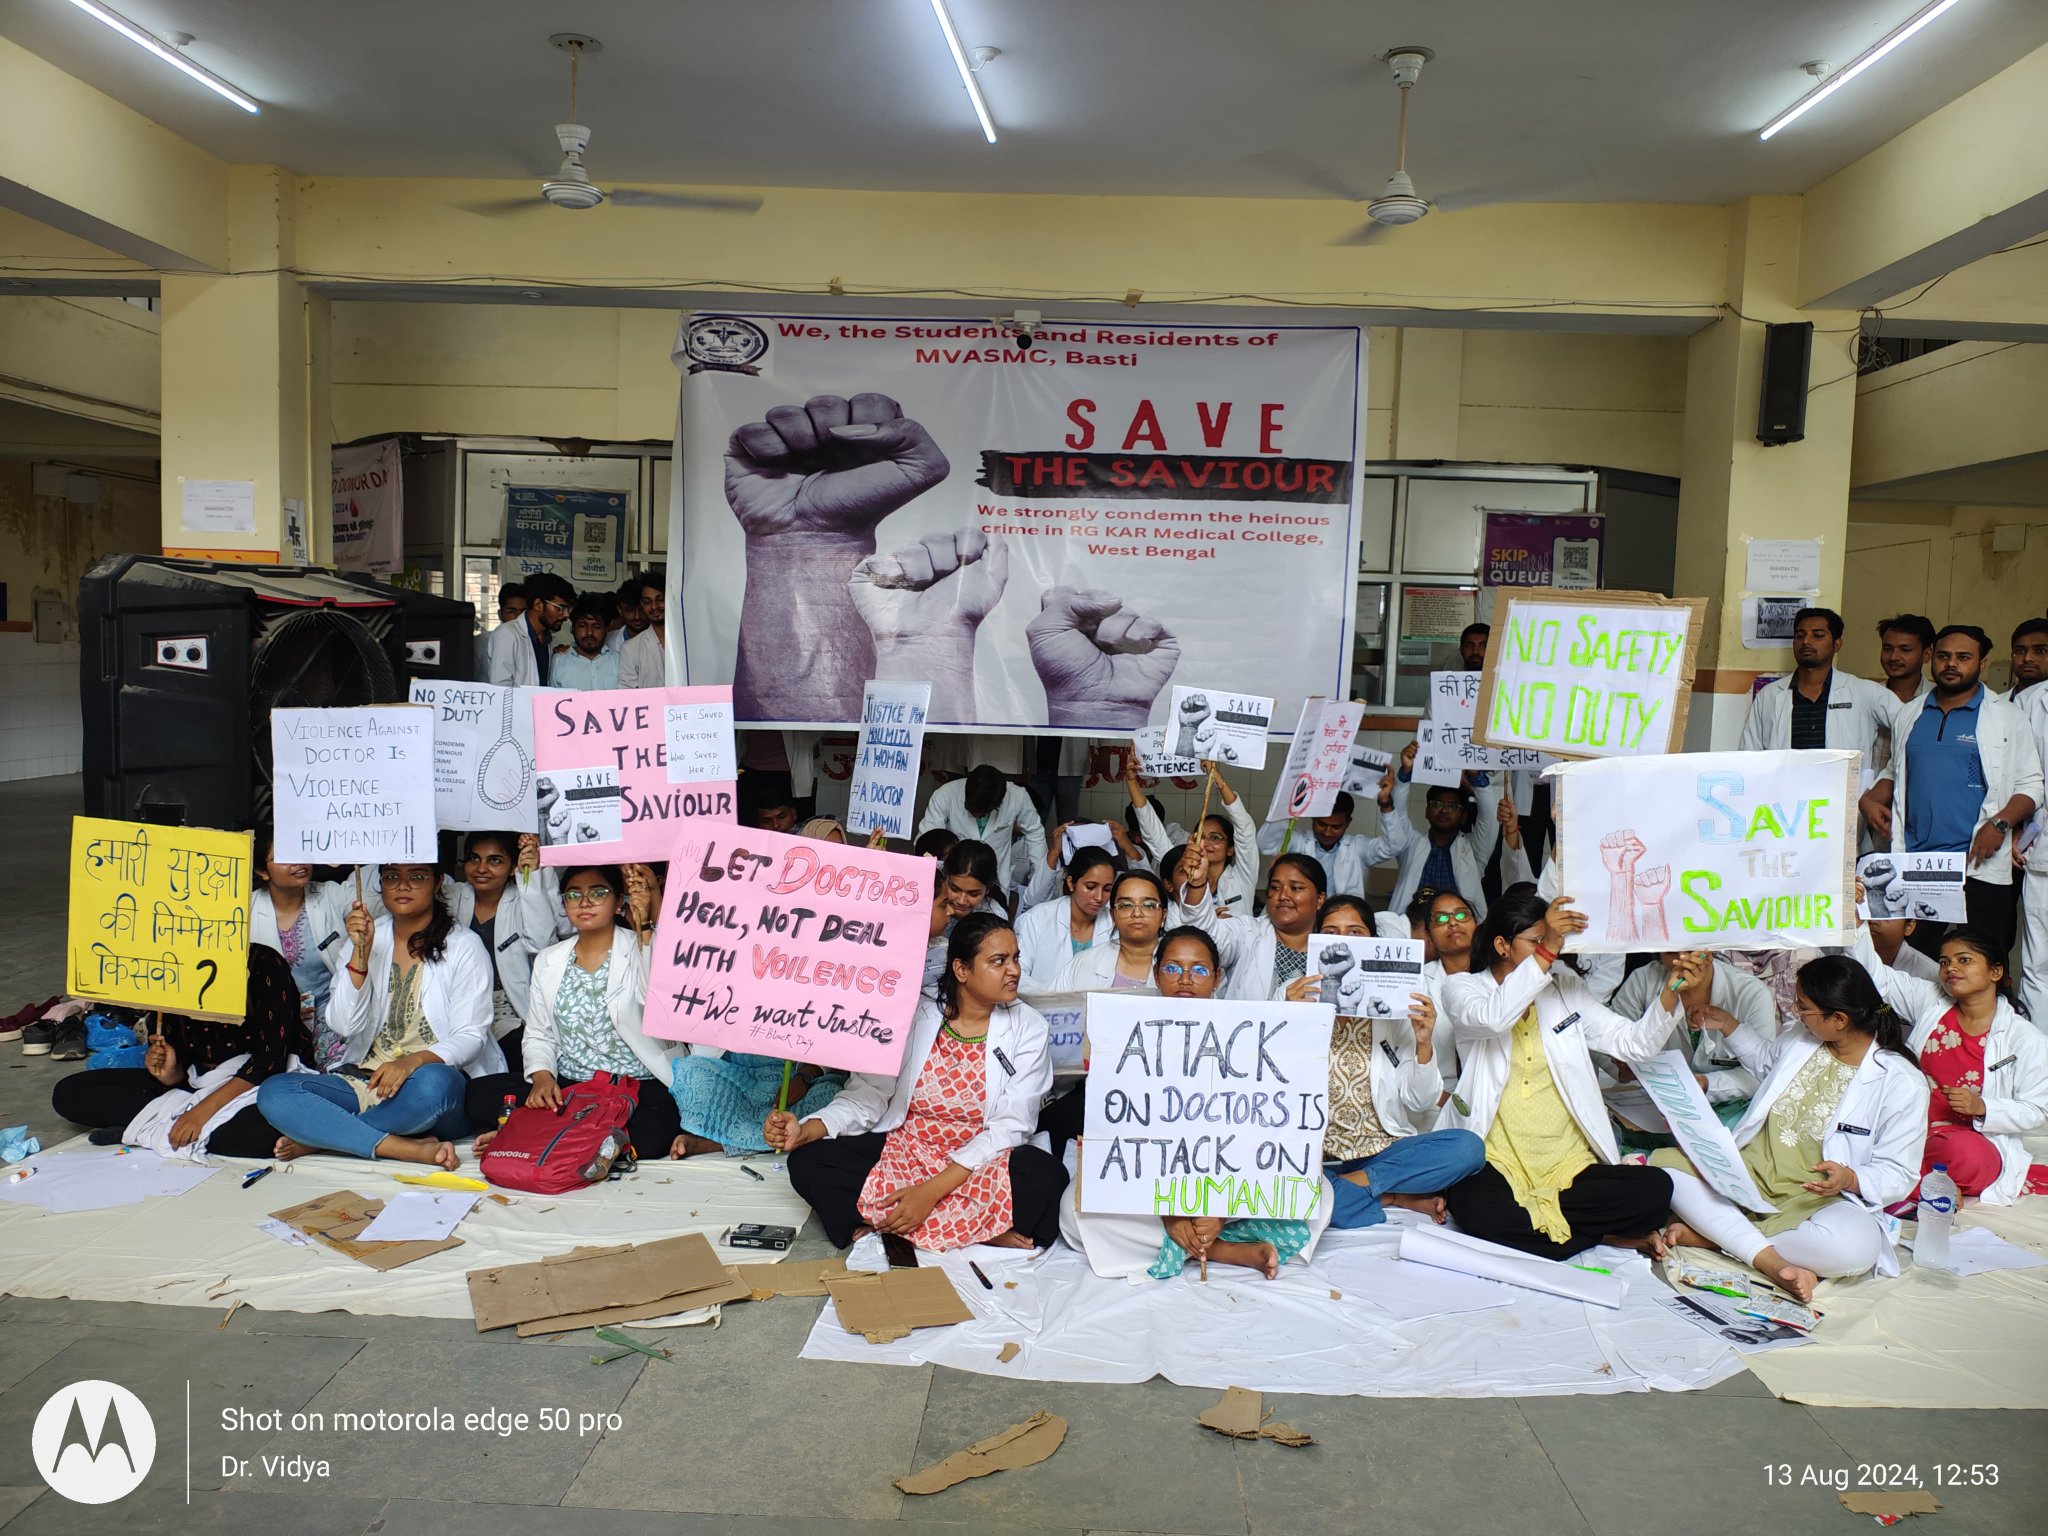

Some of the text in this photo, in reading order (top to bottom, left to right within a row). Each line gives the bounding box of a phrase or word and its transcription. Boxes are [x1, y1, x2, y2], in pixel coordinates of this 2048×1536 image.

[778, 323, 830, 340] We,
[839, 325, 887, 338] the
[1034, 329, 1086, 343] and
[1097, 330, 1240, 345] Residents
[1248, 333, 1279, 346] of
[916, 349, 1137, 366] MVASMC, Basti
[1065, 399, 1284, 454] SAVE
[1006, 456, 1334, 492] THE SAVIOUR
[977, 504, 1330, 526] We strongly condemn the heinous
[981, 522, 1324, 546] crime in RG KAR Medical College,
[1088, 544, 1216, 560] West Bengal
[1491, 549, 1528, 561] SKIP
[1490, 570, 1549, 583] QUEUE
[1505, 614, 1683, 675] NO SAFETY
[415, 689, 496, 706] NO SAFETY
[1439, 675, 1459, 697] की
[442, 707, 484, 724] DUTY
[555, 698, 649, 737] SAVE
[668, 709, 723, 722] SHE SAVED
[864, 694, 924, 724] JUSTICE FOR
[1228, 699, 1261, 715] SAVE
[1492, 679, 1663, 749] NO DUTY
[283, 717, 420, 740] VIOLENCE AGAINST
[675, 731, 718, 741] EVERYONE
[1422, 727, 1433, 743] NO
[1440, 722, 1458, 744] तो
[305, 745, 407, 764] DOCTOR IS
[612, 744, 667, 770] THE
[671, 751, 717, 761] WHO SAVED
[873, 749, 909, 771] WOMAN
[1422, 755, 1433, 770] NO
[689, 765, 704, 774] HER
[1146, 762, 1195, 773] PATIENCE
[289, 773, 380, 797] VIOLENCE
[577, 773, 611, 788] SAVE
[871, 781, 904, 806] DOCTOR
[327, 802, 402, 820] AGAINST
[1697, 770, 1830, 845] SAVE
[869, 810, 901, 834] HUMAN
[302, 829, 399, 851] HUMANITY
[85, 829, 246, 901] हमारी सुरक्षा
[700, 841, 920, 906] LET DOCTORS
[1739, 849, 1800, 878] THE
[1916, 859, 1952, 870] SAVE
[1680, 870, 1834, 932] SAVIOUR
[100, 893, 139, 942] की
[676, 891, 887, 947] HEAL, NOT DEAL
[1375, 946, 1410, 960] SAVE
[92, 942, 184, 992] किसकी
[673, 939, 901, 996] WITH VOILENCE
[753, 1001, 815, 1027] want
[1116, 1019, 1290, 1084] ATTACK
[1105, 1086, 1326, 1131] ON DOCTORS IS
[1100, 1134, 1310, 1181] ATTACK ON
[1153, 1175, 1321, 1220] HUMANITY
